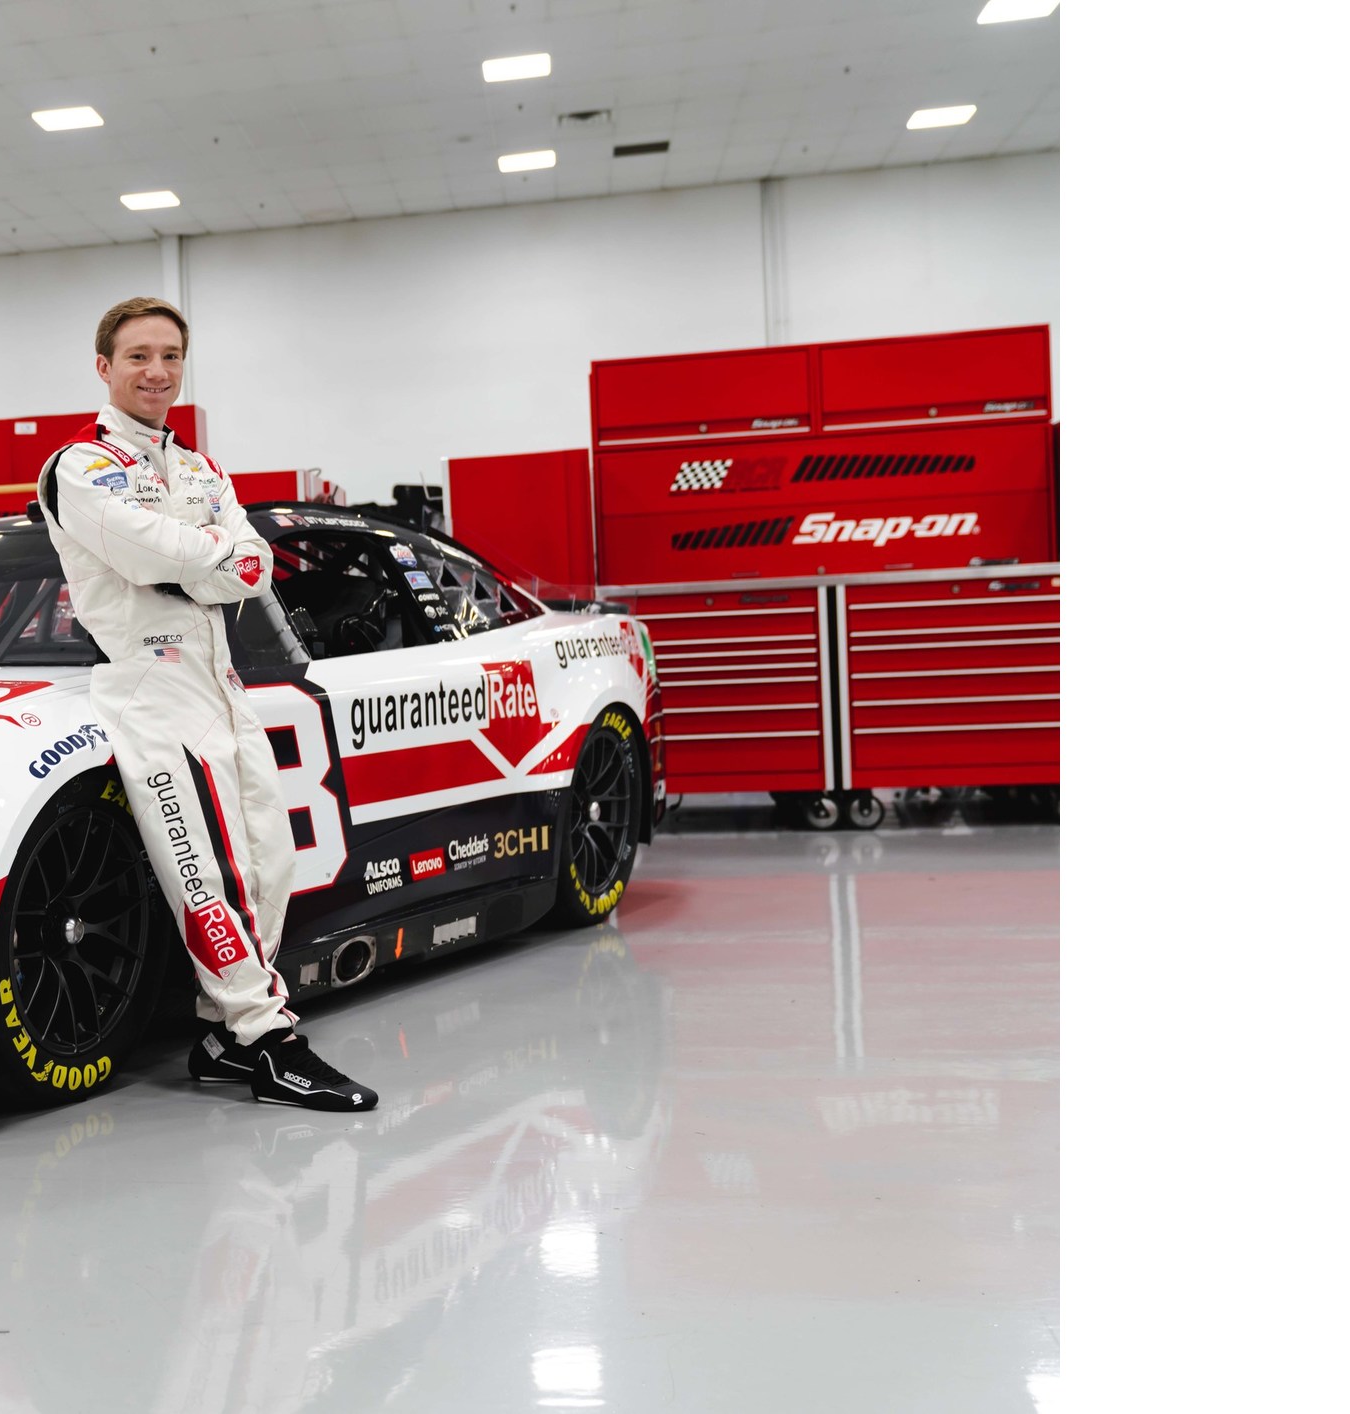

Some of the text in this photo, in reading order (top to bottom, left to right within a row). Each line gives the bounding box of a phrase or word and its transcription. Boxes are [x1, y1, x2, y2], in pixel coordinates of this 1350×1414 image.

[792, 511, 978, 547] Snap-on
[236, 558, 258, 575] Rate
[143, 633, 183, 646] sparco
[350, 672, 538, 750] guaranteed Rate
[602, 712, 632, 740] EAGLE
[28, 725, 109, 779] GOODY
[244, 682, 348, 897] 8
[448, 833, 489, 861] Cheddar's
[494, 825, 549, 860] 3CHI
[147, 771, 238, 963] guaranteed Rate
[364, 857, 401, 881] ALSCO
[412, 856, 443, 875] Lenovo
[367, 875, 403, 895] UNIFORMS
[569, 863, 625, 915] GOODYEAR
[283, 1071, 312, 1089] sparco
